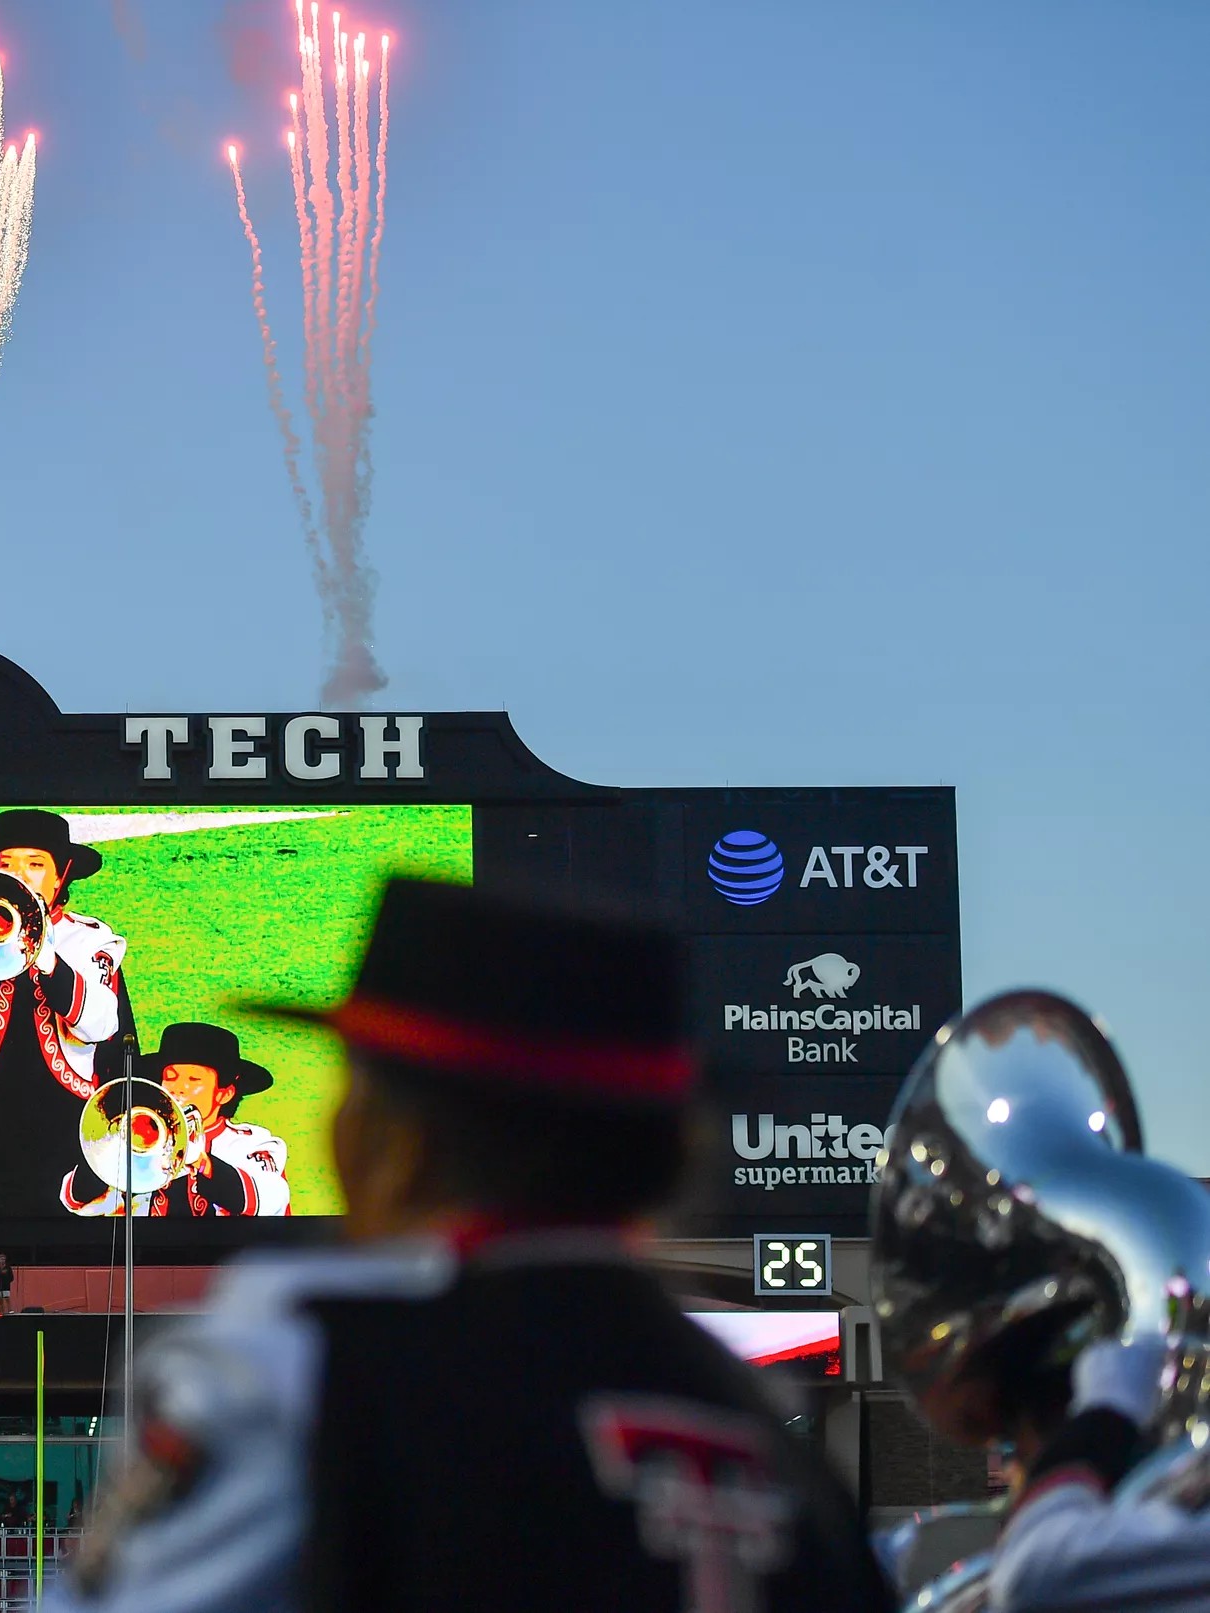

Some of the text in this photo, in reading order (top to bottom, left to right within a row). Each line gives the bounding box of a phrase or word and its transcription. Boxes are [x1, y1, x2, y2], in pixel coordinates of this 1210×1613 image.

[125, 715, 425, 780] TECH
[799, 845, 928, 888] AT&T
[724, 1004, 921, 1035] PlainsCapital
[787, 1037, 858, 1063] Bank
[731, 1113, 896, 1160] Unite
[734, 1160, 882, 1190] supermark
[763, 1241, 823, 1288] 25
